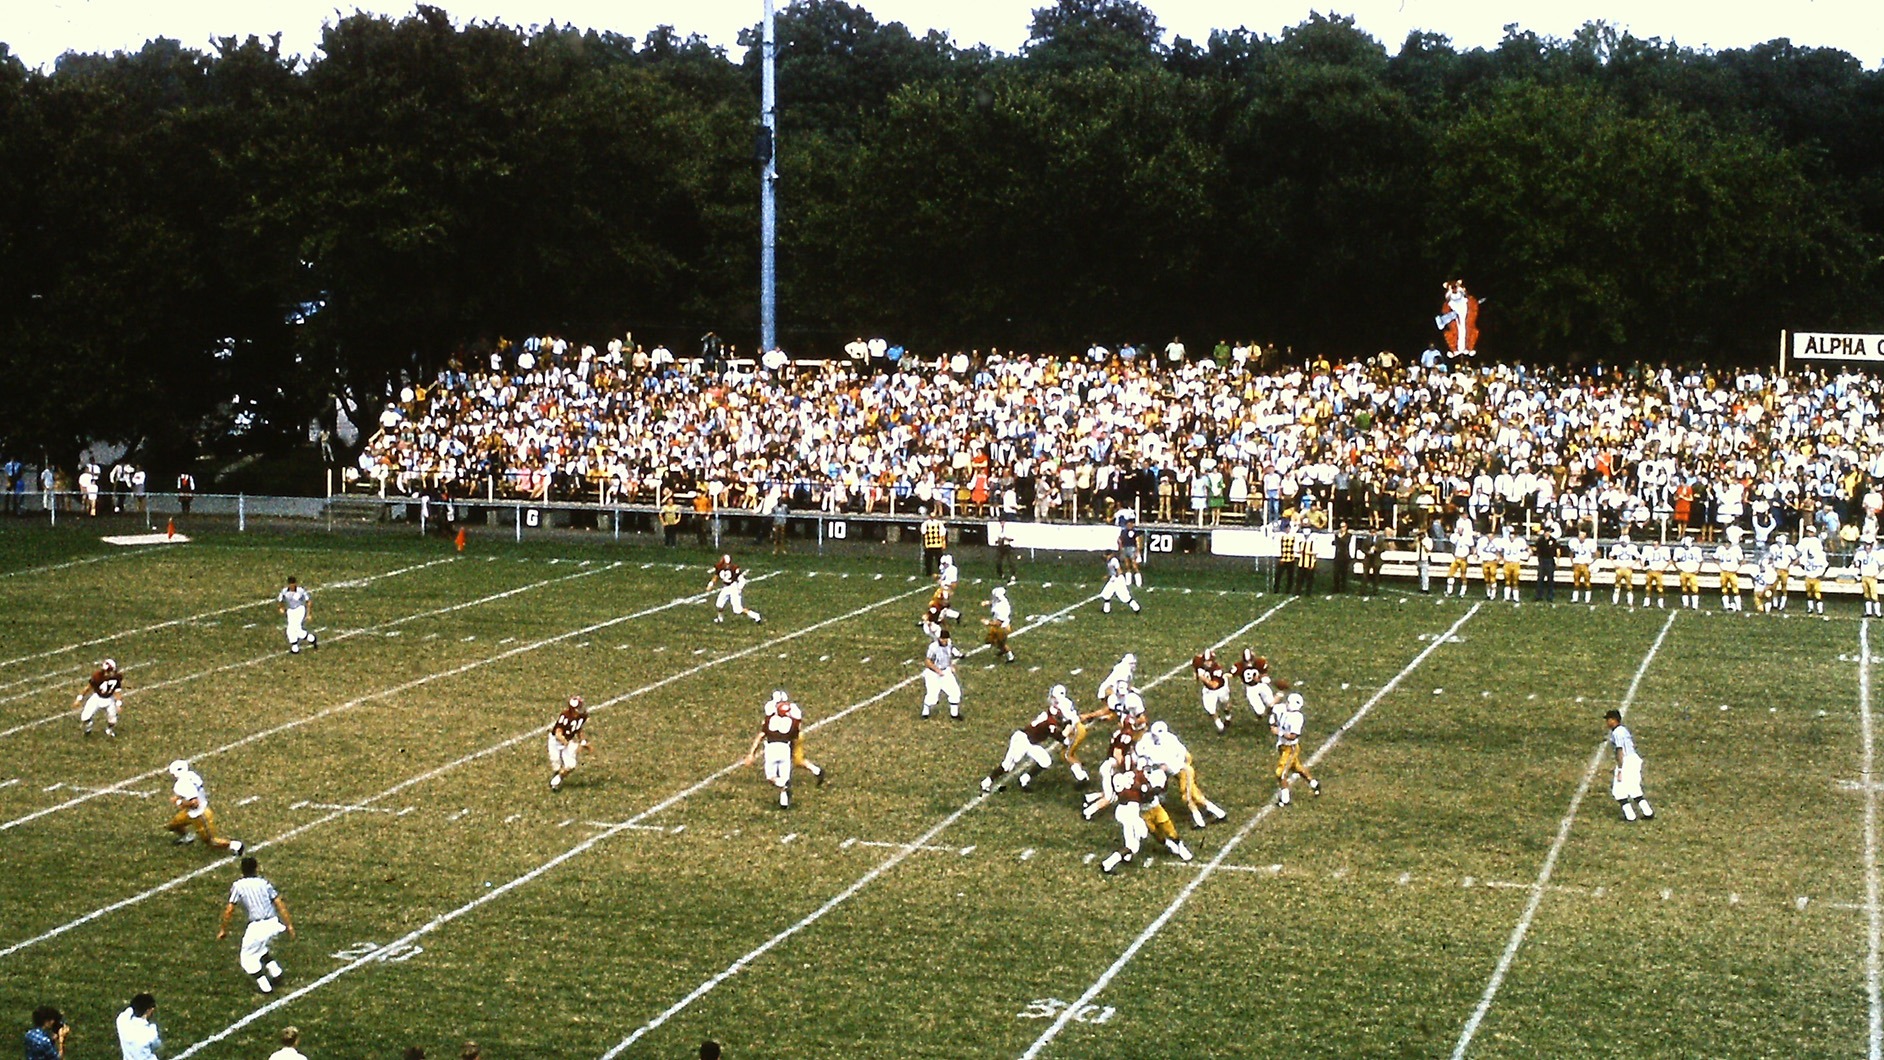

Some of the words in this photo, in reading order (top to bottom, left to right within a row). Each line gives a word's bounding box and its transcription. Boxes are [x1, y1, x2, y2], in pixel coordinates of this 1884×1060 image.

[1804, 335, 1866, 356] ALPHA
[526, 509, 539, 527] G
[828, 521, 847, 539] 10
[1149, 534, 1173, 552] 20
[99, 679, 118, 694] 47
